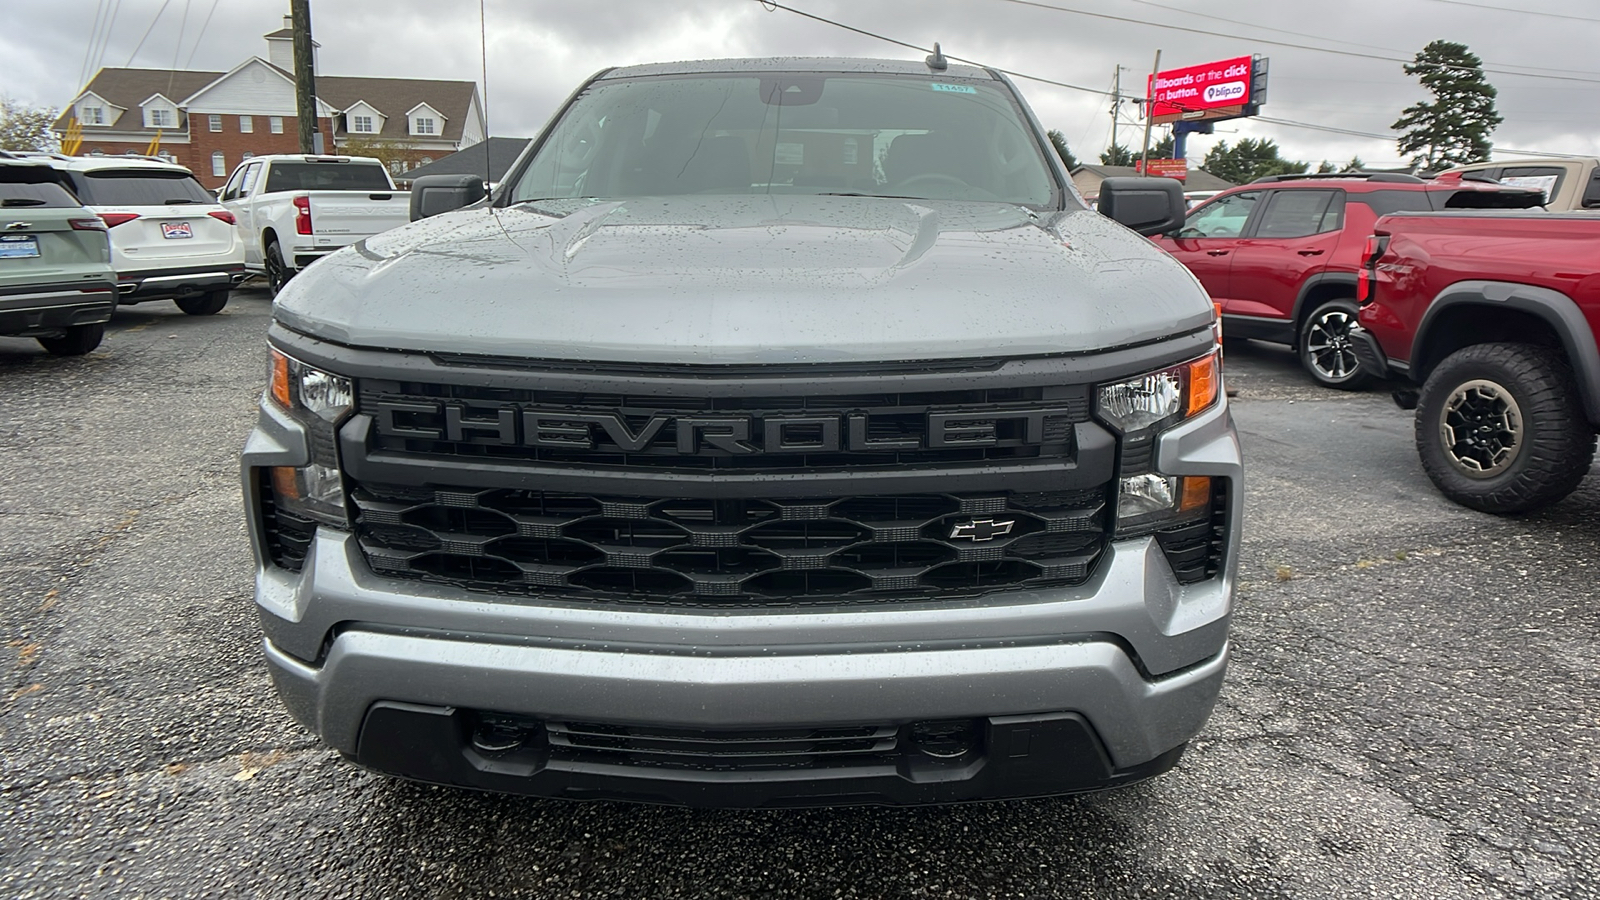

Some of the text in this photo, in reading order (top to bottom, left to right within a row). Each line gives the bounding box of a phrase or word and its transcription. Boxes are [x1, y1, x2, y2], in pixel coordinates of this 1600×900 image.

[1150, 64, 1248, 91] illboards at the click
[1166, 87, 1199, 100] button.
[1215, 86, 1242, 98] blip.co
[376, 402, 1070, 454] CHEVROLET
